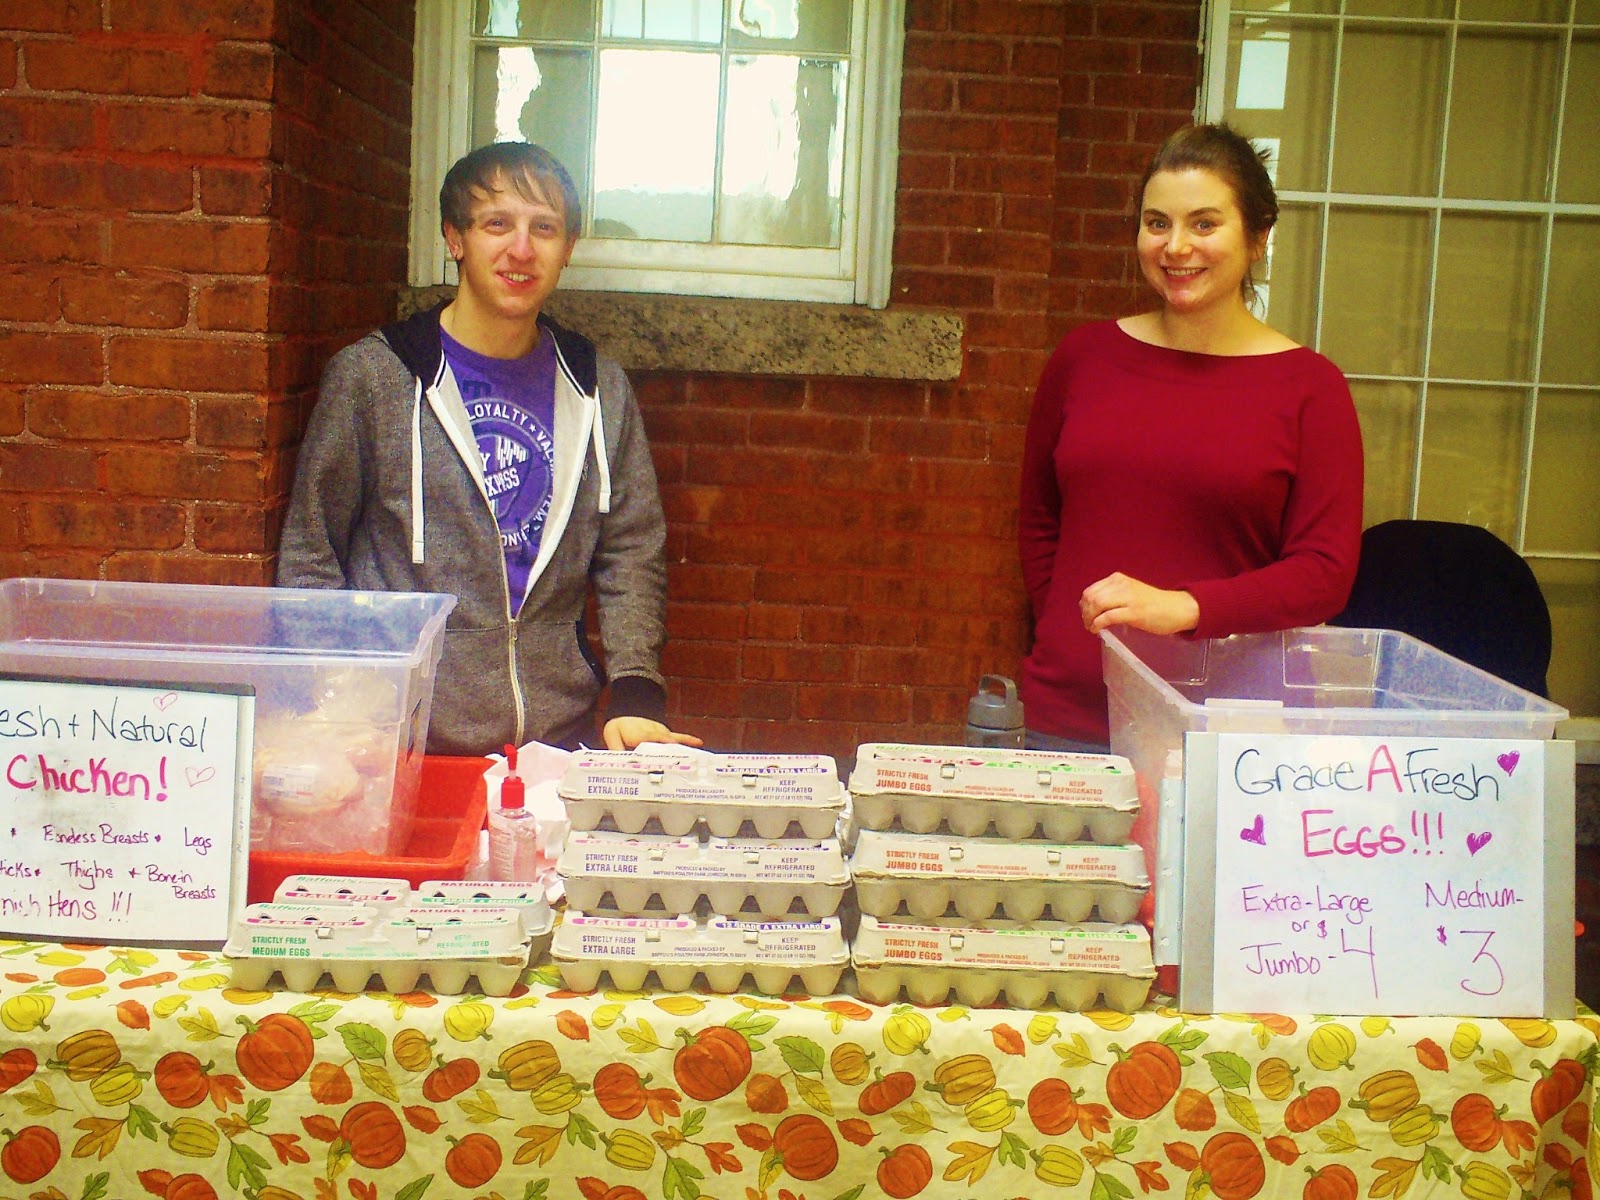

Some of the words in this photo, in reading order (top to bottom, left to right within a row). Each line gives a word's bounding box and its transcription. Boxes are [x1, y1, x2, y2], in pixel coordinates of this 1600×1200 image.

[465, 403, 529, 425] LOYALTY
[92, 696, 207, 752] Natural
[6, 754, 168, 801] Chicken!
[877, 769, 906, 777] STRICTLY
[908, 772, 928, 780] FRESH
[1367, 744, 1403, 793] A
[1403, 748, 1499, 801] Fresh
[588, 776, 617, 784] STRICTLY
[619, 777, 639, 785] FRESH
[876, 780, 907, 789] JUMBO
[910, 783, 931, 792] EGGS
[588, 785, 612, 794] EXTRA
[615, 787, 639, 795] LARGE
[99, 823, 150, 845] Breasts
[184, 827, 212, 856] Legs
[585, 863, 611, 871] EXTRA
[613, 864, 638, 873] LARGE
[886, 861, 917, 870] JUMBO
[920, 863, 943, 872] EGGS
[61, 860, 113, 890] Thighs
[172, 885, 216, 899] Breasts
[49, 890, 97, 920] Hens
[1242, 884, 1374, 925] Extra-Large
[1291, 919, 1310, 932] or
[252, 936, 283, 944] STRICTLY
[583, 935, 612, 943] STRICTLY
[918, 941, 938, 949] FRESH
[252, 947, 286, 956] MEDIUM
[289, 948, 311, 956] EGGS
[583, 945, 608, 953] EXTRA
[611, 947, 635, 955] LARGE
[885, 949, 916, 958] JUMBO
[919, 952, 942, 960] EGGS
